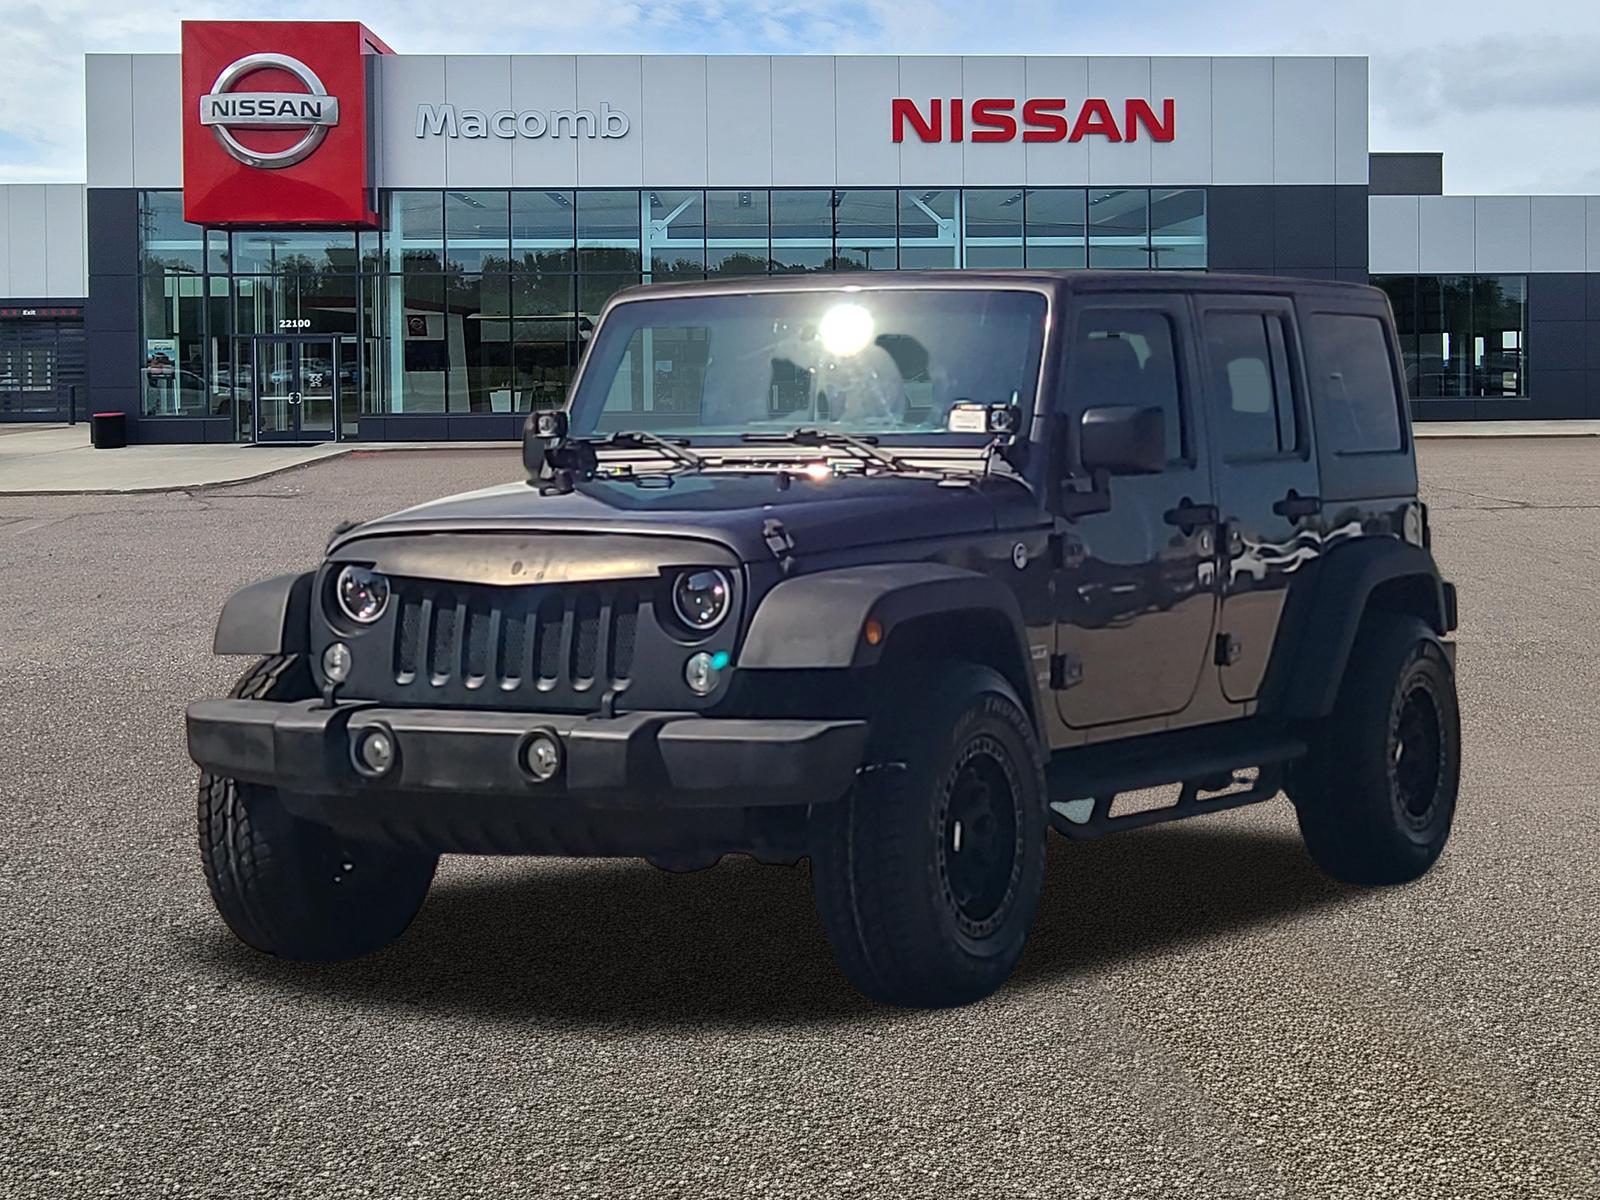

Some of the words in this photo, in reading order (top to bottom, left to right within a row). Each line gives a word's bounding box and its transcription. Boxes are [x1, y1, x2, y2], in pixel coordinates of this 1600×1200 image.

[211, 100, 322, 118] NISSAN
[415, 101, 630, 139] Macomb
[892, 97, 1175, 142] NISSAN
[279, 319, 311, 328] 22100
